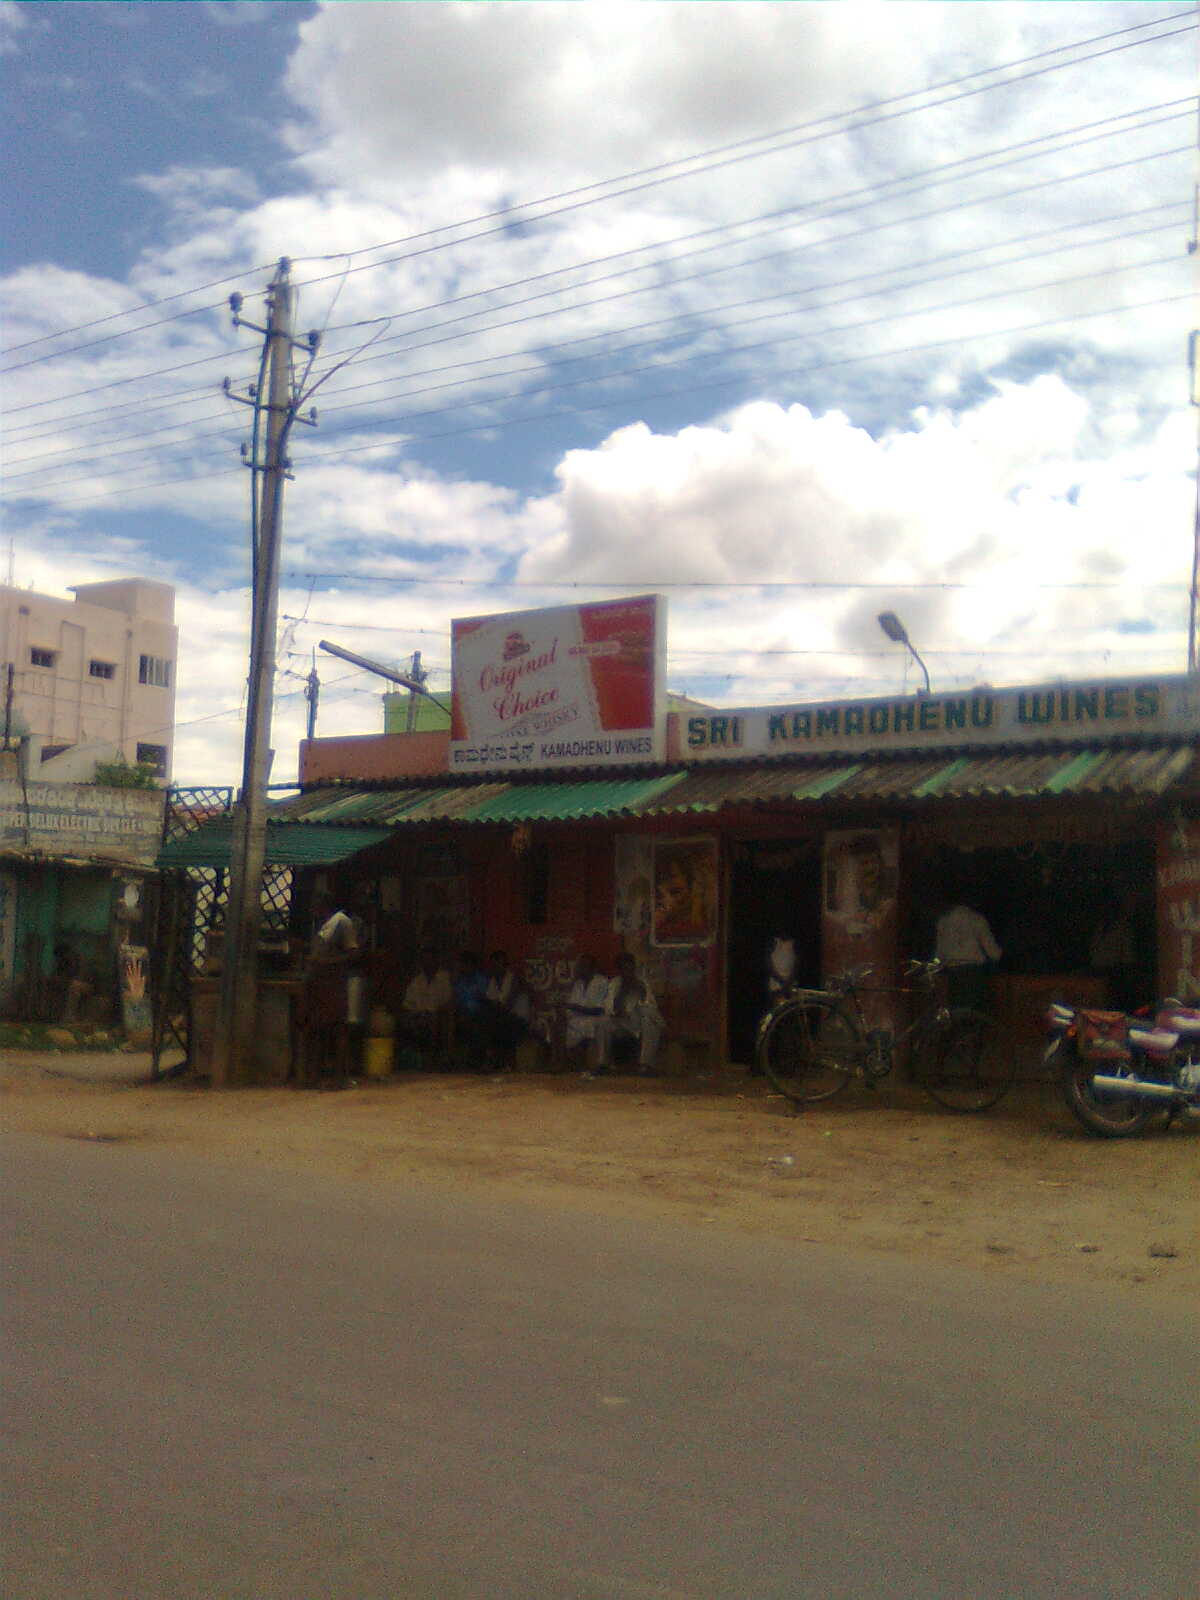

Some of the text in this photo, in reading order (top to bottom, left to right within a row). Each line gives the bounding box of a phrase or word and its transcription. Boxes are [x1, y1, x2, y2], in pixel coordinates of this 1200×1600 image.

[479, 636, 559, 694] Original
[493, 686, 559, 721] Choice
[687, 683, 1161, 747] SRI KAMADHENU WINES
[540, 740, 612, 758] KAMADHENU
[614, 737, 652, 753] WINES
